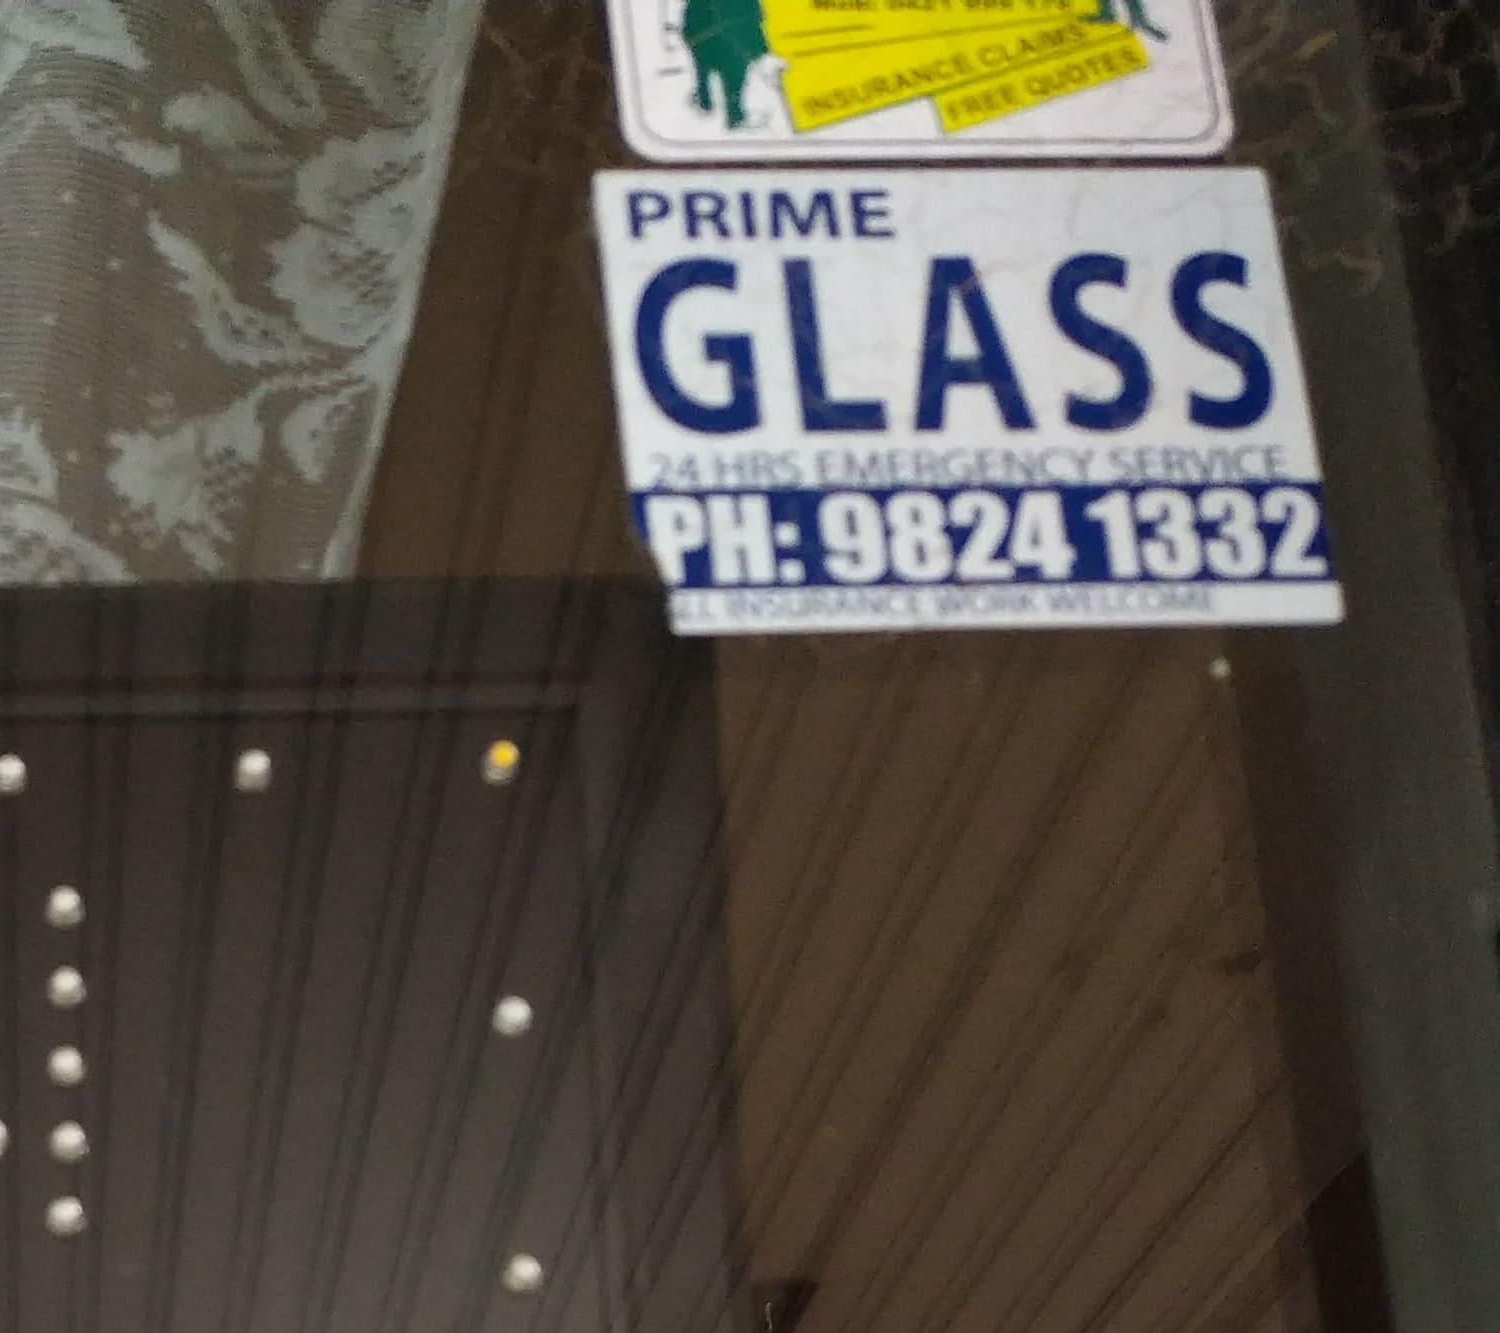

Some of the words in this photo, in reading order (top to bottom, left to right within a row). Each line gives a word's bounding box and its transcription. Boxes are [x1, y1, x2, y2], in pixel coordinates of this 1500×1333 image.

[804, 51, 964, 117] INSURANCE
[980, 23, 1086, 67] CLAIMS
[946, 76, 1014, 120] FREE
[1027, 44, 1140, 96] QUOTES
[626, 190, 896, 239] PRIME
[633, 251, 1275, 435] GLASS
[648, 452, 697, 488] 24
[707, 449, 799, 487] HRS
[816, 446, 1093, 485] EMERGENCY
[1100, 443, 1288, 483] SERVICE
[645, 490, 806, 587] PH:
[818, 488, 1077, 585] 9824
[1085, 484, 1328, 581] 1332
